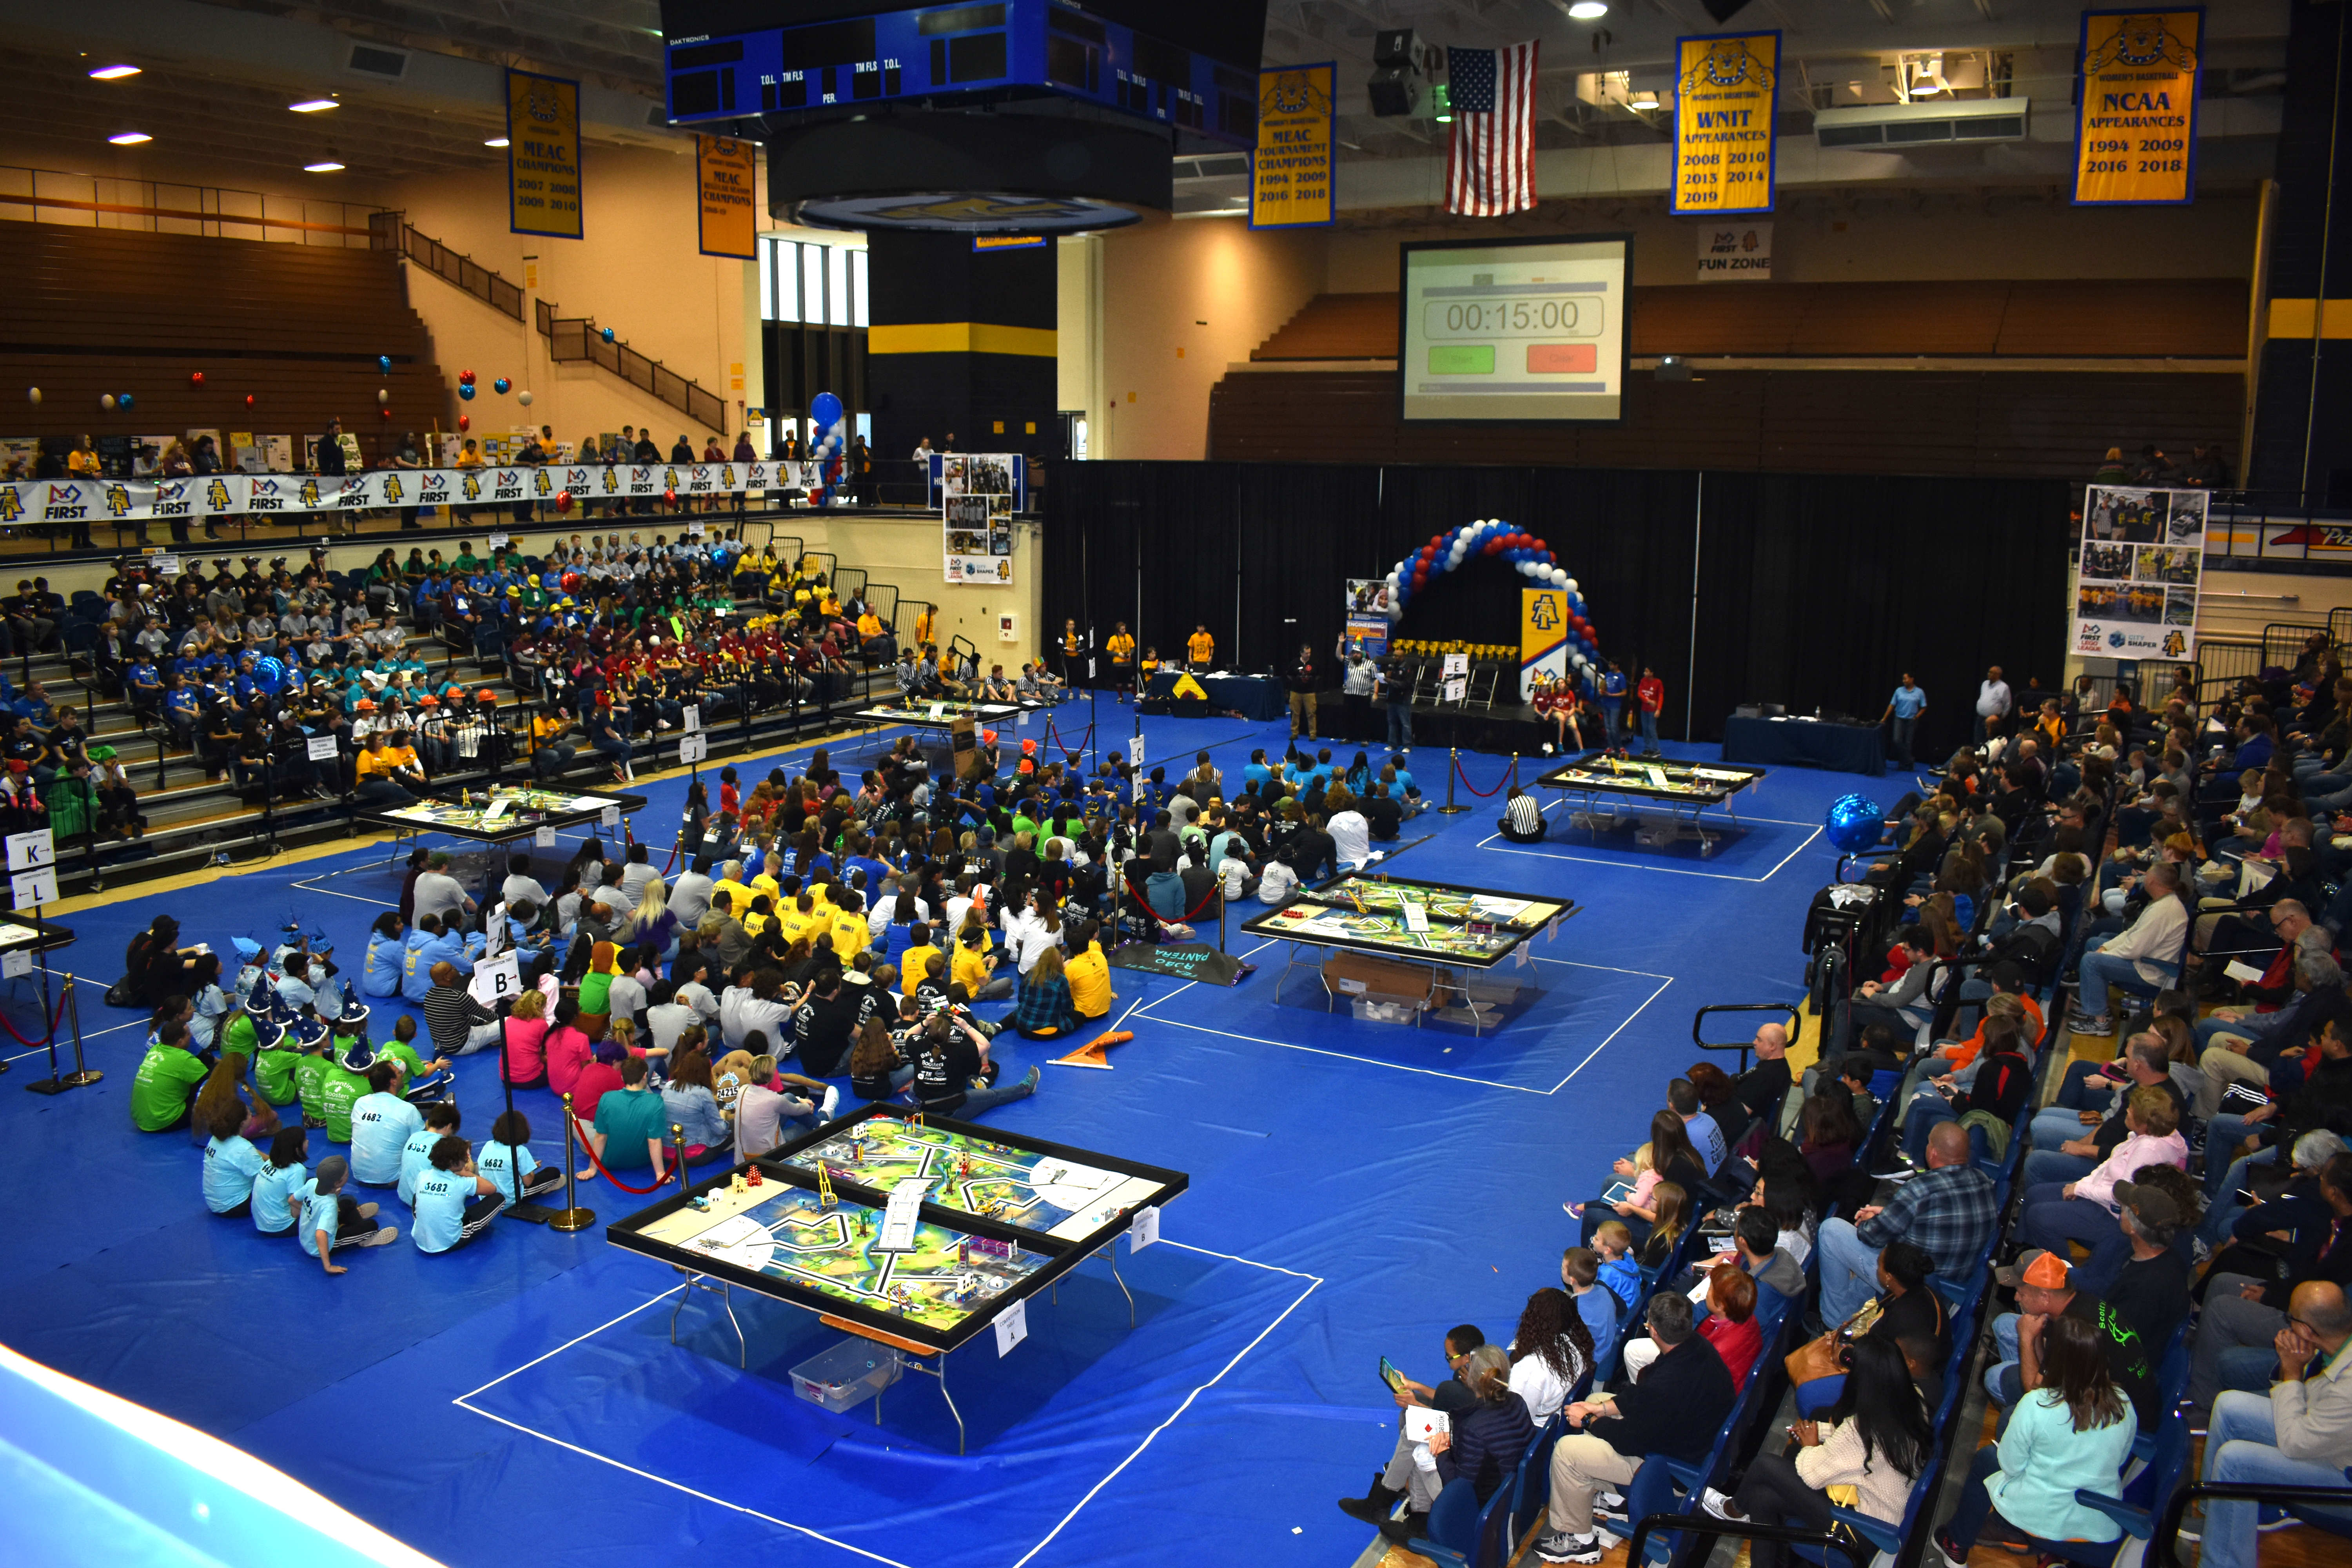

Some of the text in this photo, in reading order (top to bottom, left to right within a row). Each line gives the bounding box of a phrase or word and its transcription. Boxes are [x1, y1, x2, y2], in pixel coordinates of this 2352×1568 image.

[670, 35, 710, 45] DAKTRONICS
[856, 61, 877, 73] TM FLS
[884, 59, 901, 69] T.O.L.
[761, 75, 777, 85] T.O.L.
[783, 71, 803, 82] TM FLS
[2099, 72, 2178, 82] WOMEN'S BASKETBALL
[823, 93, 837, 103] PER.
[2103, 92, 2171, 111] NCAA
[1697, 110, 1752, 128] WNIT
[2088, 116, 2185, 129] APPEARANCES
[1273, 129, 1312, 143] MEAC
[1684, 131, 1767, 143] APPEARANCES
[524, 140, 566, 162] MEAC
[1259, 143, 1327, 156] TOURNAMENT
[2089, 140, 2184, 152] 1994 2009
[1258, 155, 1327, 170] CHAMPIONS
[1684, 152, 1766, 165] 2008 2010
[517, 158, 575, 175] CHAMPIONS
[2087, 160, 2181, 172] 2016 2018
[714, 171, 740, 185] MEAC
[1260, 171, 1326, 185] 1994 2009
[1727, 170, 1763, 183] 2014
[517, 178, 576, 195] 2007 2008
[704, 191, 751, 207] CHAMPIONS
[1260, 189, 1326, 202] 2016 2018
[1684, 192, 1718, 203] 2019
[519, 196, 577, 211] 2009 2010
[1711, 245, 1737, 253] FIRST
[1698, 258, 1771, 270] FUN ZONE
[1447, 301, 1578, 331] 00:15:00
[631, 483, 653, 493] FIRST
[690, 481, 712, 491] FIRST
[746, 479, 768, 488] FIRST
[419, 491, 449, 503] FIRST
[495, 488, 523, 499] FIRST
[249, 498, 284, 509] FIRST
[338, 494, 369, 506] FIRST
[45, 506, 88, 519] FIRST
[152, 501, 191, 515] FIRST
[1454, 662, 1459, 671] E
[1455, 688, 1459, 697] F
[692, 746, 696, 759] J
[1137, 748, 1141, 761] C
[1138, 783, 1142, 796] D
[26, 845, 39, 863] K
[33, 884, 43, 901] L
[496, 927, 503, 948] A
[1155, 949, 1210, 961] PANTERA
[1155, 958, 1195, 970] ROBO
[495, 973, 507, 994] B
[325, 1080, 355, 1093] Ballentine
[718, 1087, 738, 1098] 24215
[325, 1090, 349, 1100] Boosters
[361, 1113, 382, 1122] 6682
[408, 1143, 427, 1152] 6682
[485, 1159, 503, 1168] 6682
[262, 1164, 277, 1176] 6682
[425, 1182, 448, 1192] 6682
[1134, 1213, 1153, 1227] COMPETITION
[1142, 1233, 1145, 1242] B
[1000, 1308, 1020, 1327] COMPETITION
[1007, 1319, 1015, 1329] TABLE
[1011, 1332, 1015, 1342] A
